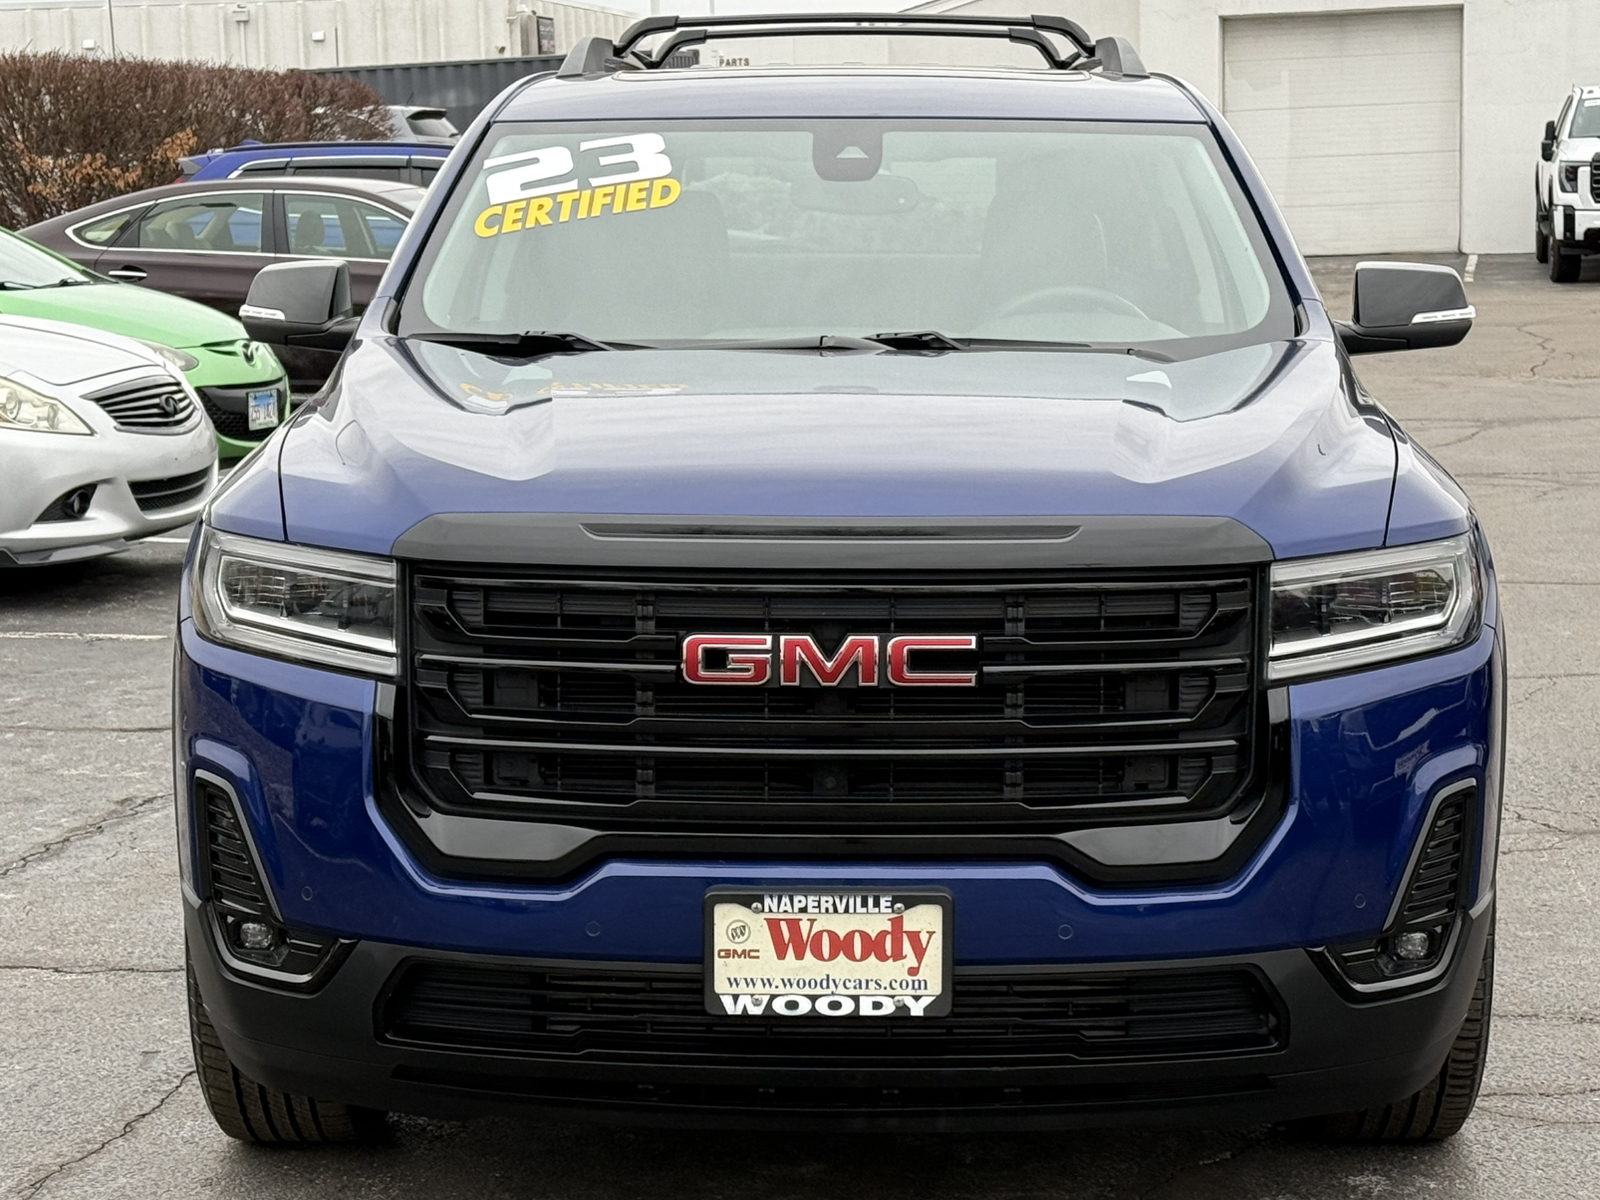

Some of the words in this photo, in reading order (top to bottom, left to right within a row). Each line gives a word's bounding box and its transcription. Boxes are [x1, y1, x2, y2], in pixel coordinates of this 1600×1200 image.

[719, 57, 750, 67] PARTS
[483, 132, 673, 206] 23
[474, 177, 682, 239] CERTIFIED
[681, 634, 978, 687] GMC
[763, 895, 893, 914] NAPERVILLE
[717, 949, 760, 960] GMC
[764, 915, 936, 977] Woody
[727, 974, 928, 994] www.woodycars.com
[718, 995, 938, 1017] WOODY
